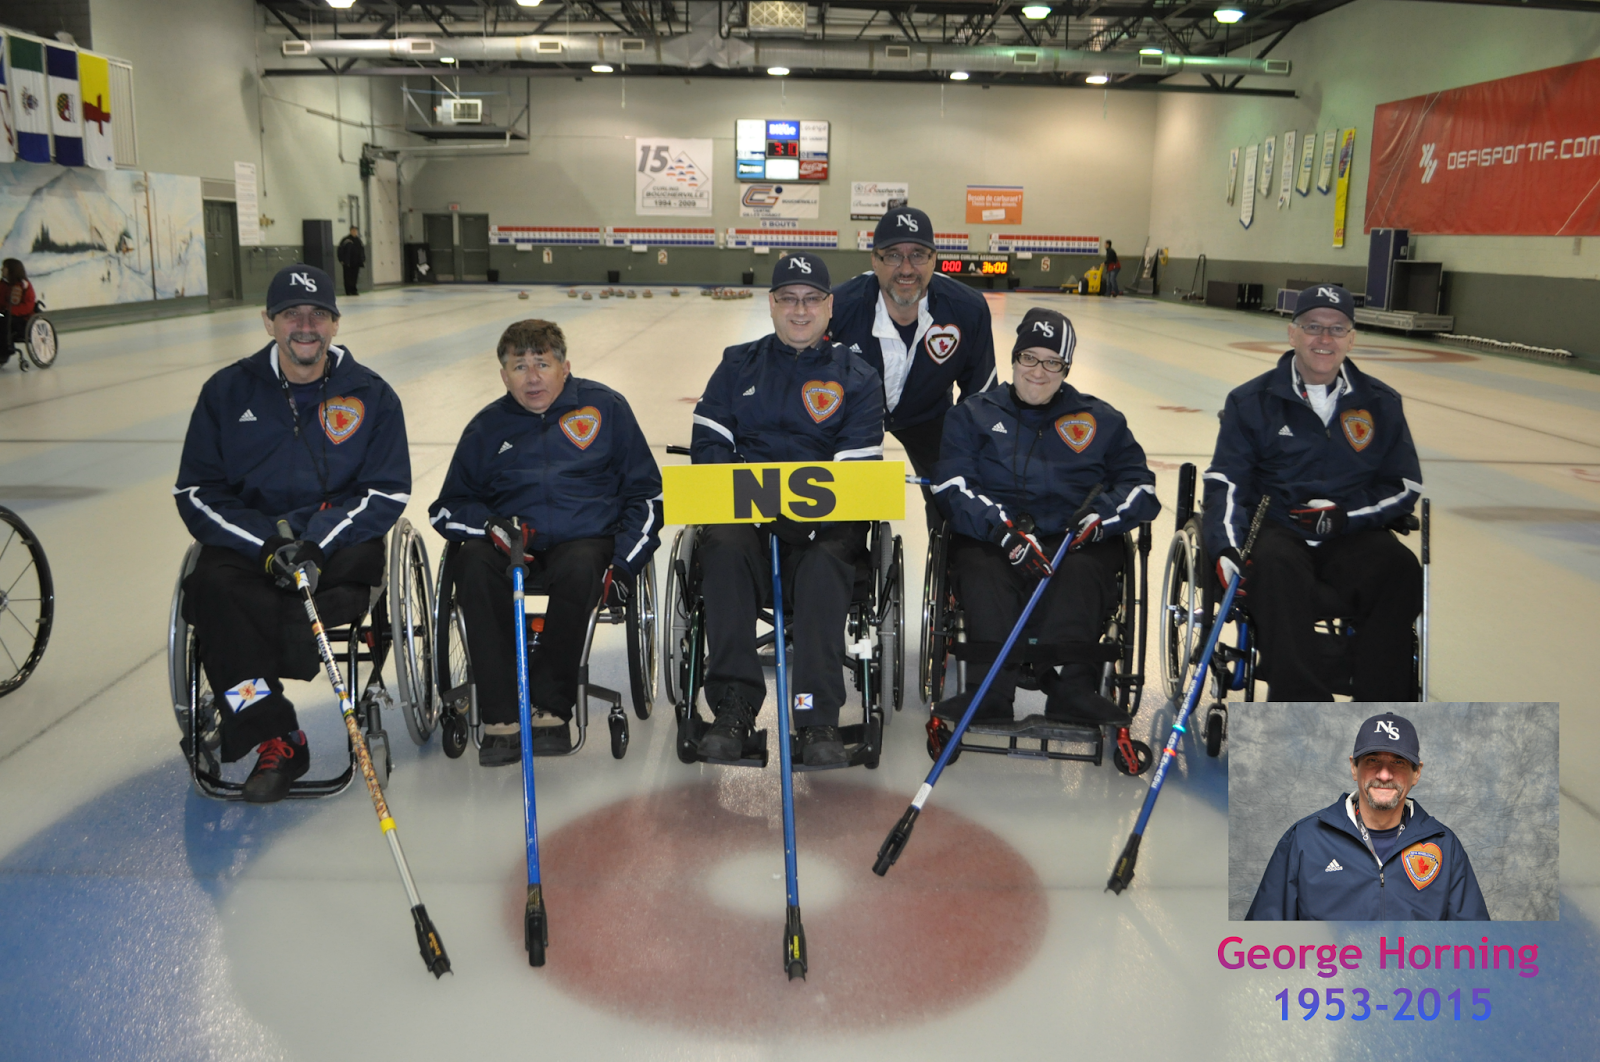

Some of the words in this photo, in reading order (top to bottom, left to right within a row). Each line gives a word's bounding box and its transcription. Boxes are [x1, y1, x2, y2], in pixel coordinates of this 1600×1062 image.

[638, 145, 669, 173] 15
[1447, 135, 1600, 170] DEFISPORTIF.COM
[896, 214, 919, 232] NS
[660, 252, 667, 263] 2
[788, 257, 812, 274] NS
[1042, 259, 1049, 270] 5
[942, 260, 962, 272] 0:00
[982, 261, 1008, 274] 36:00
[289, 272, 318, 292] NS
[1316, 286, 1340, 304] NS
[1032, 320, 1054, 338] NS
[732, 466, 837, 519] NS
[1374, 720, 1400, 740] NS
